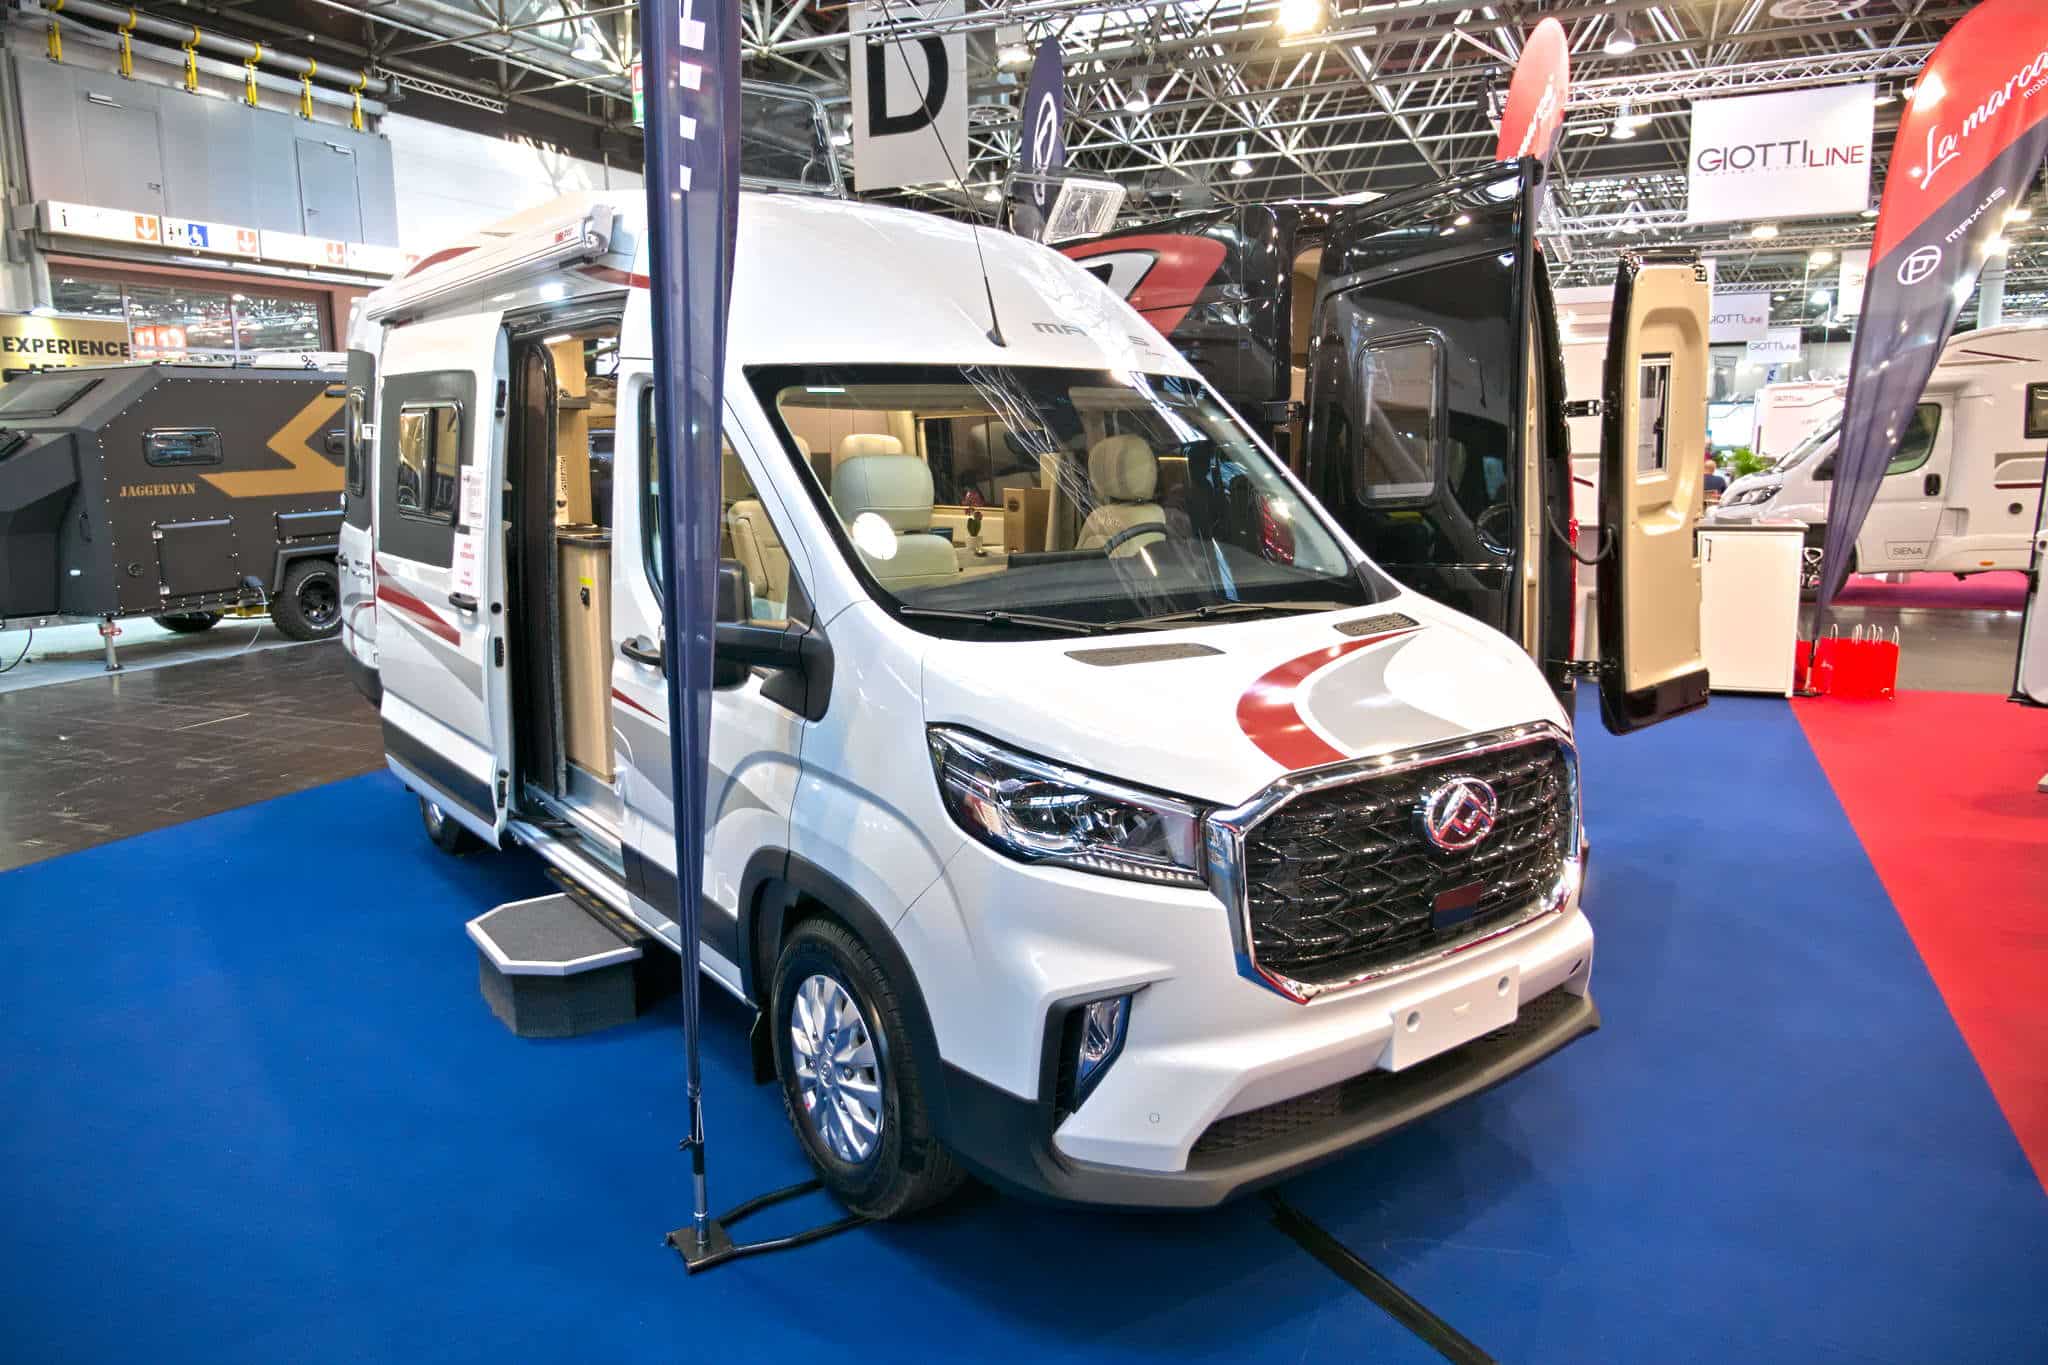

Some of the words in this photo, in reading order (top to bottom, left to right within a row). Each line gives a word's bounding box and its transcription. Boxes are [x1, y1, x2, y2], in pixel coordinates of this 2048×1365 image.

[866, 17, 949, 138] D
[1920, 124, 1961, 191] La
[1944, 186, 2007, 243] MAXUS
[2, 335, 131, 358] EXPERIENCE
[1031, 321, 1150, 347] MAS
[119, 482, 196, 497] JAGGERVAN
